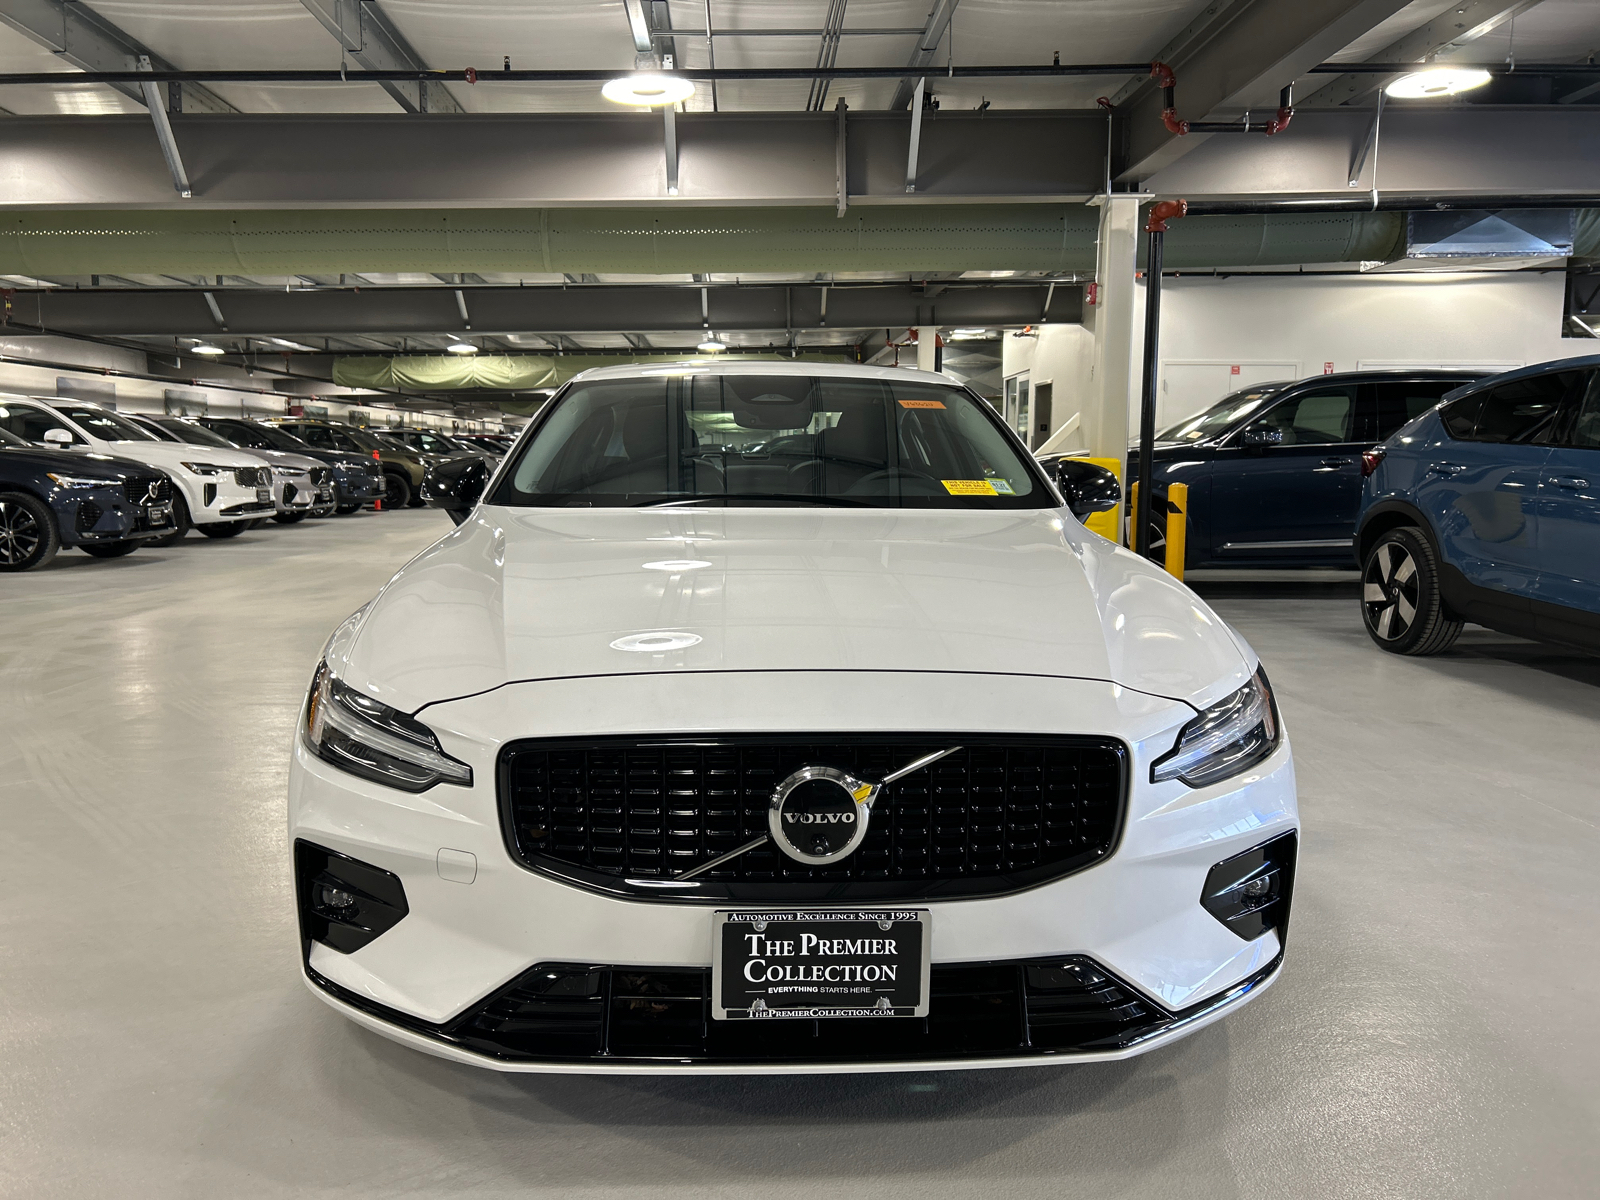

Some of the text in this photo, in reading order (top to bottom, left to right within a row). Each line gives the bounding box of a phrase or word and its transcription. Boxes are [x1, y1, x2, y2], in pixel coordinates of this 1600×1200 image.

[783, 812, 855, 824] VOLVO
[730, 912, 917, 921] AUTOMOTIVE EXCELLENCE SINCE 1995
[744, 933, 898, 957] THE PREMIER
[743, 959, 898, 983] COLLECTION
[768, 986, 818, 994] EVERYTHING
[820, 986, 849, 994] STARTS
